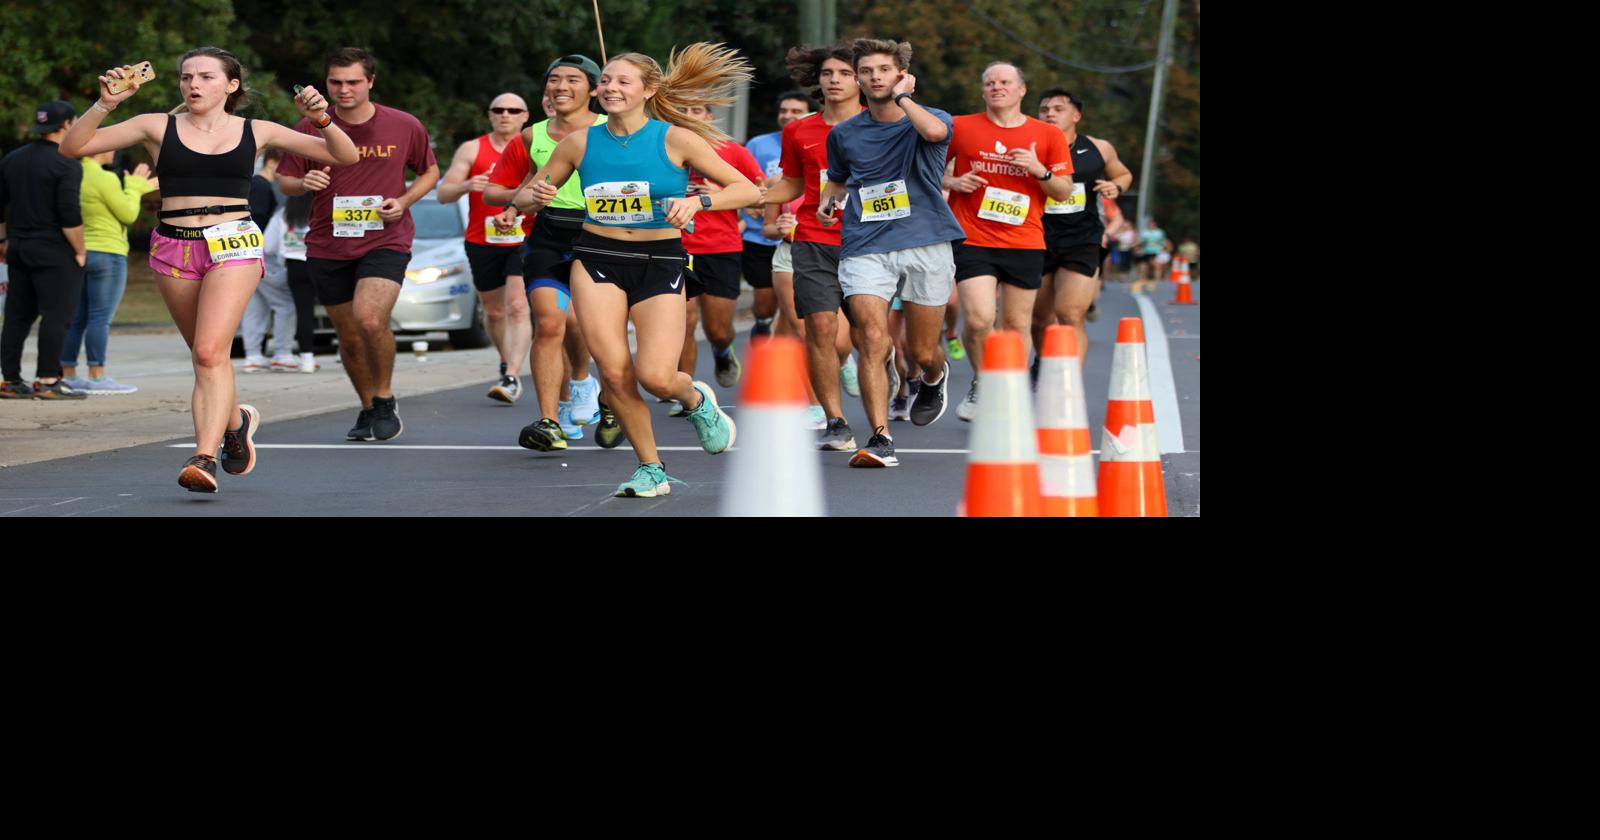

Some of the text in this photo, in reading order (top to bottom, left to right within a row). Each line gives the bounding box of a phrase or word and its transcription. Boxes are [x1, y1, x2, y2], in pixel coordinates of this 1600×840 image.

[595, 197, 642, 213] 2714
[873, 196, 896, 213] 651
[989, 200, 1021, 217] 1636
[344, 209, 372, 222] 337
[218, 233, 259, 251] 1610
